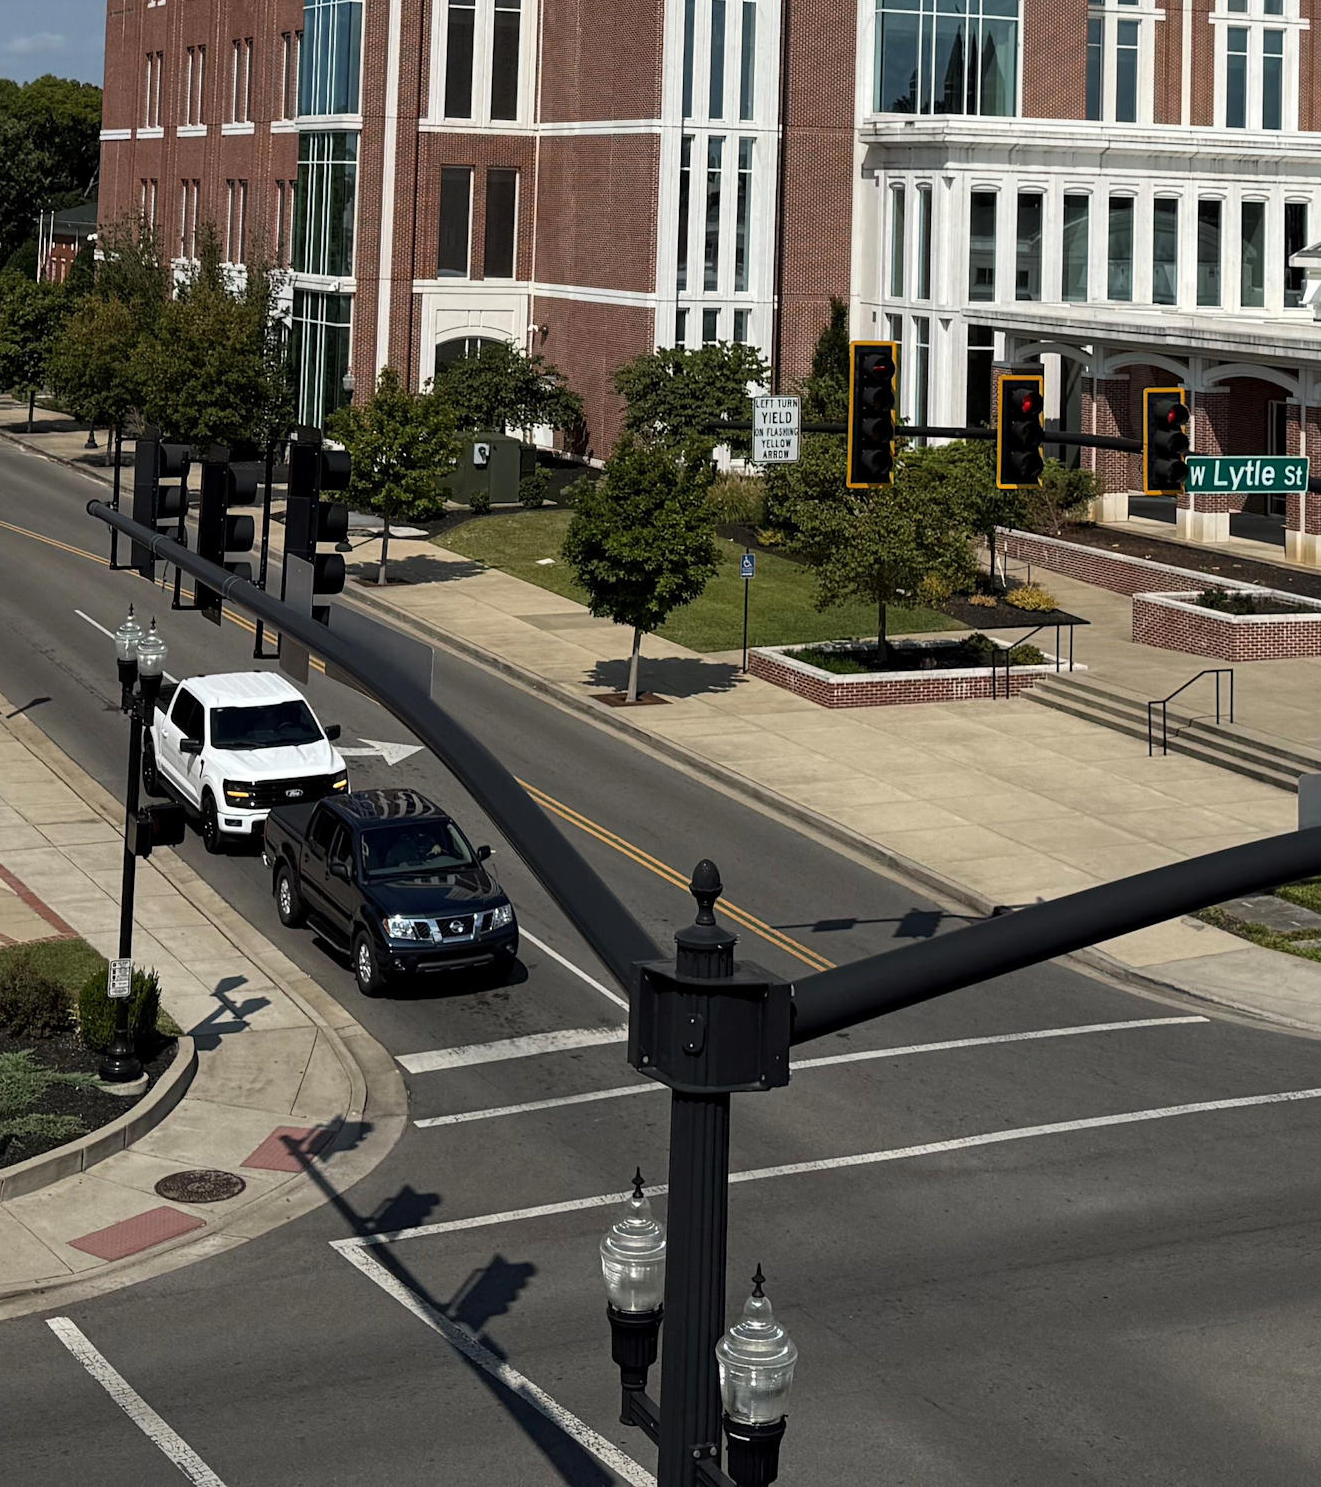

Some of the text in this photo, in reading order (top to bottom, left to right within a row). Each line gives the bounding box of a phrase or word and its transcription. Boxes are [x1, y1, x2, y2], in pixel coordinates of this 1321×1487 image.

[755, 399, 798, 408] LEFT TURN
[762, 412, 792, 424] YIELD
[755, 427, 798, 437] ON FLASHING
[762, 439, 791, 448] YELLOW
[763, 450, 789, 458] ARROW
[1190, 459, 1303, 491] W Lytle St
